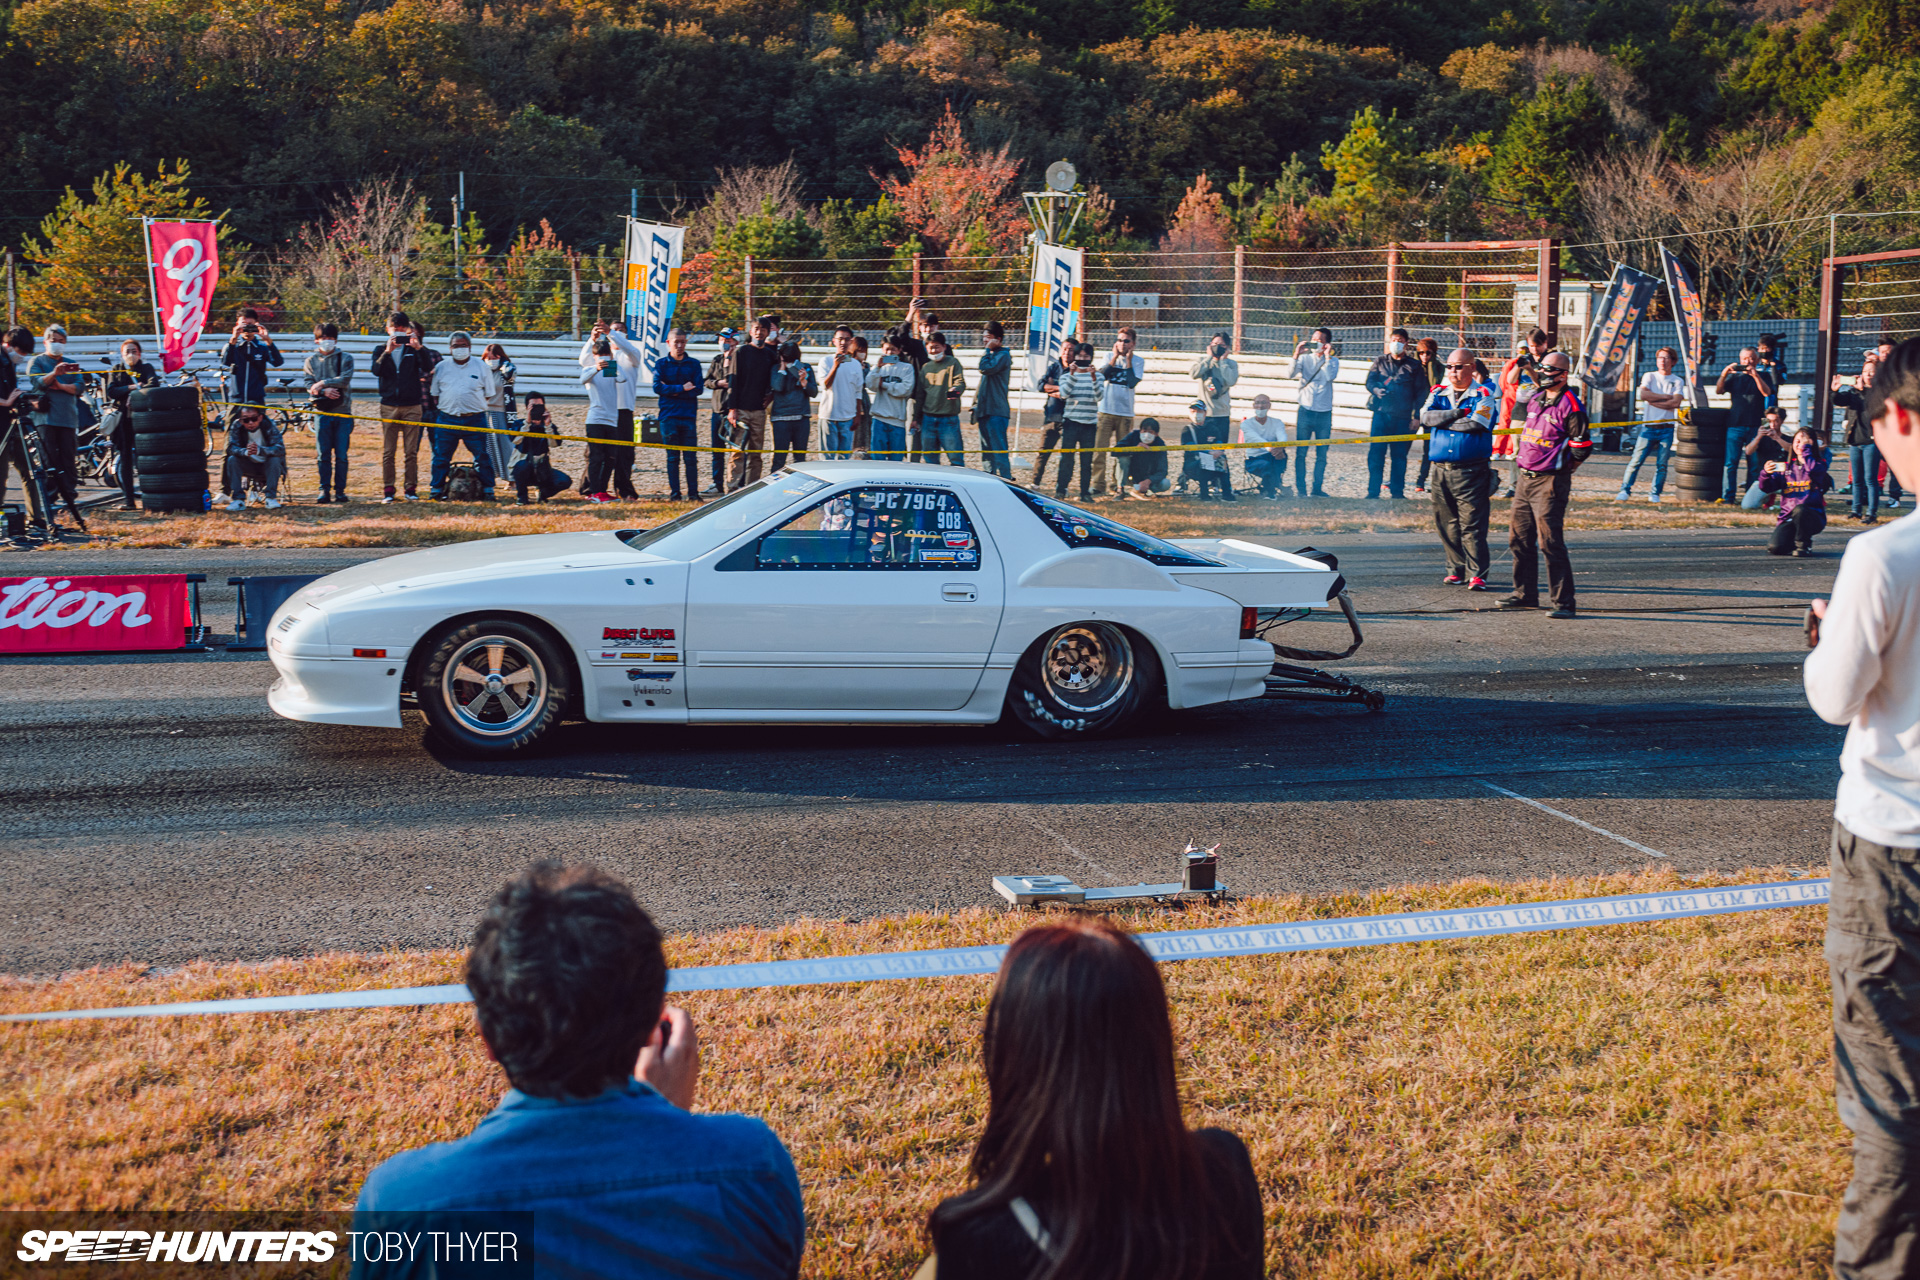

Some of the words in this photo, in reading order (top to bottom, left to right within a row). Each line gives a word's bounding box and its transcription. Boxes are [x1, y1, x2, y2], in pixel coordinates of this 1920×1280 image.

[1562, 297, 1575, 316] 14
[1586, 276, 1636, 377] FESTIVAL
[1609, 304, 1641, 363] DRAG
[875, 492, 898, 509] PC
[903, 493, 947, 511] 7964
[937, 512, 961, 530] 908
[0, 578, 152, 629] tion
[602, 627, 638, 640] DIRECT
[640, 627, 676, 640] CLUTCH
